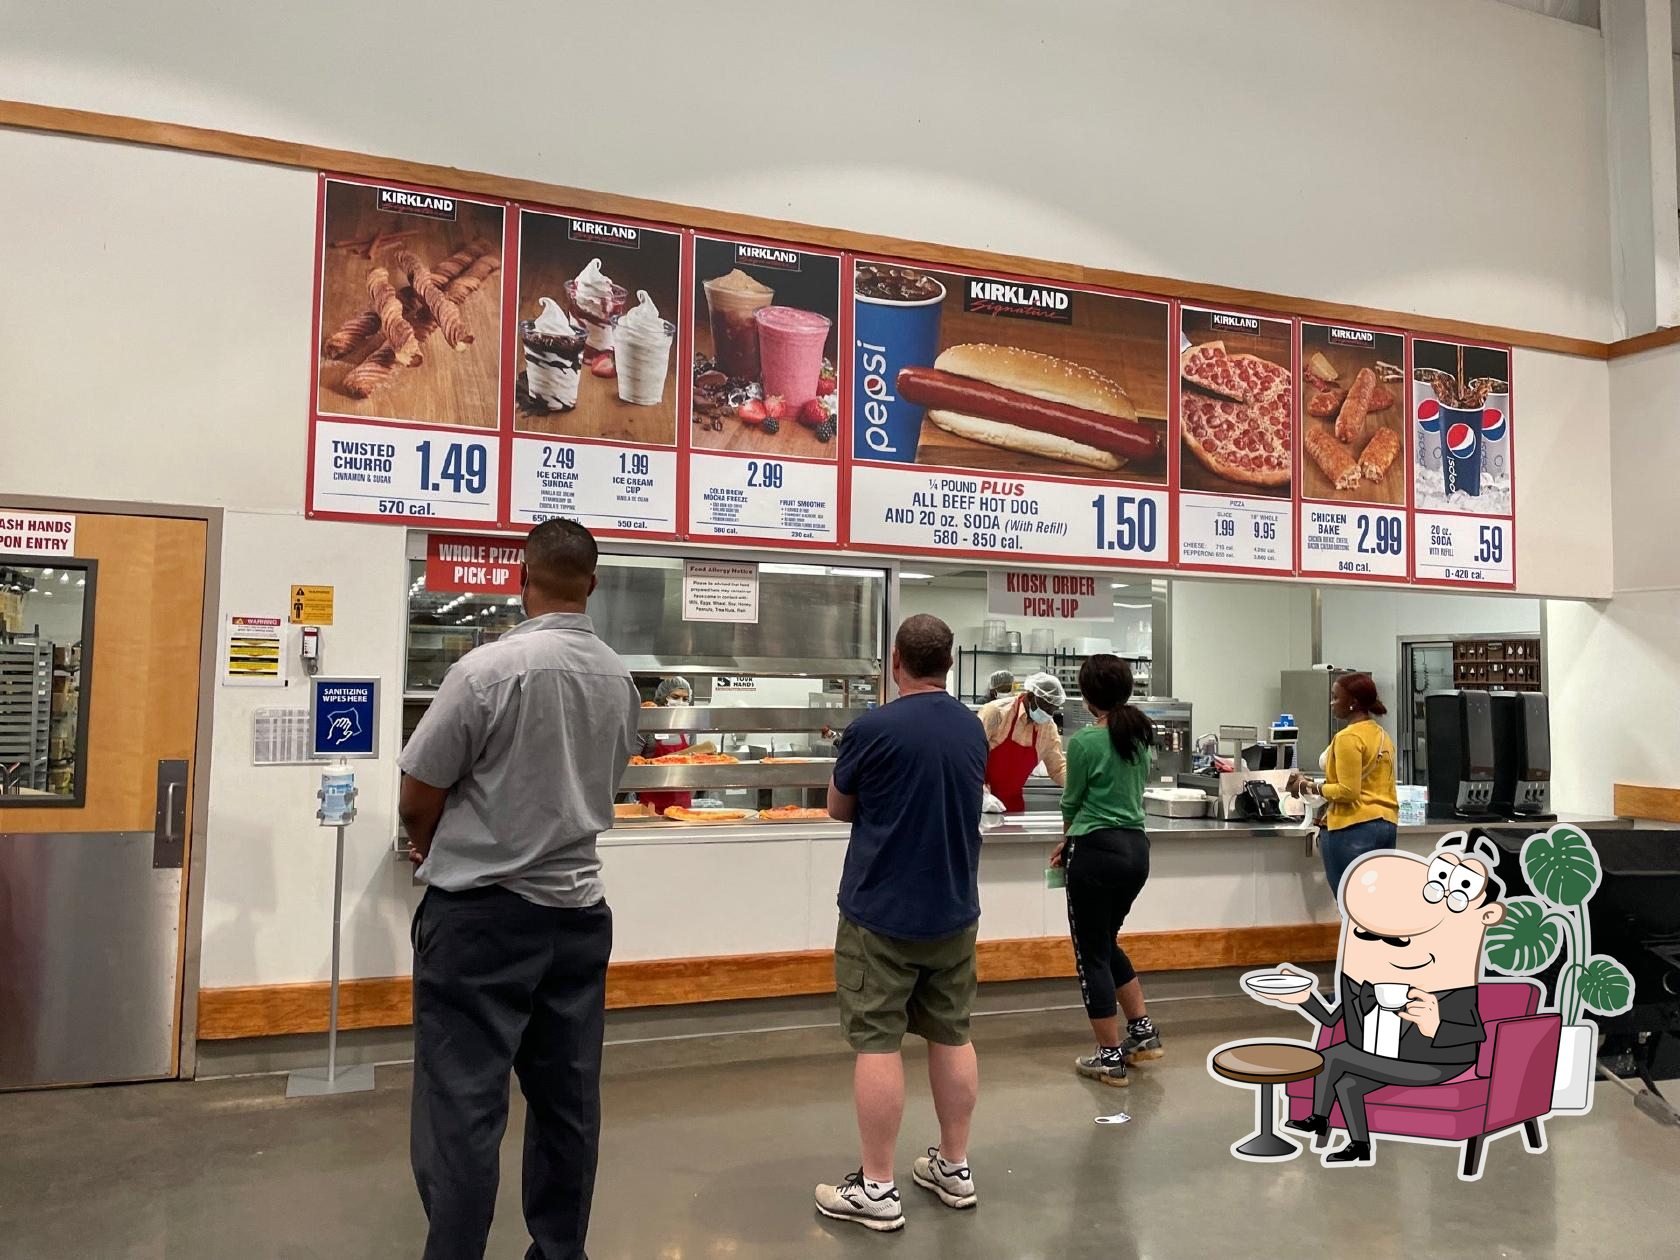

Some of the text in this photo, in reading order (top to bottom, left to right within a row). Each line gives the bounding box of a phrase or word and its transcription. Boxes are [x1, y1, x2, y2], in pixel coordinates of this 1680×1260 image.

[382, 191, 453, 212] KIRKLAND
[572, 220, 636, 240] KIRKLAND
[738, 246, 796, 262] KIRKLAND
[971, 282, 1068, 310] KIRKLAND
[970, 300, 1068, 319] Signature
[1214, 314, 1258, 328] KIRKLAND
[1332, 328, 1372, 341] KIRKLAND
[857, 340, 896, 452] pepsi
[332, 440, 395, 458] TWISTED
[542, 446, 575, 470] 2.49
[334, 456, 392, 472] CHURRO
[416, 440, 487, 494] 1.49
[620, 452, 648, 475] 1.99
[334, 472, 391, 484] CINNAMON & SUGAR
[537, 470, 578, 480] ICE CREAM
[627, 478, 653, 486] CREAM
[747, 461, 782, 488] 2.99
[1446, 456, 1457, 492] pepsi
[542, 480, 573, 488] SUNDAE
[941, 480, 977, 493] POUND
[980, 480, 1025, 496] PLUS
[379, 500, 435, 515] 570 cal.
[912, 492, 1038, 515] ALL BEEF HOT DOG
[28, 520, 72, 533] HANDS
[885, 508, 1067, 536] AND 20 oz. SODA (With Refill)
[1092, 494, 1156, 552] 1.50
[1312, 512, 1347, 524] CHICKEN
[1214, 519, 1234, 536] 1.99
[1254, 522, 1275, 540] 9.95
[1318, 524, 1340, 535] BAKE
[1357, 514, 1402, 555] 2.99
[1431, 525, 1440, 534] 20
[26, 537, 68, 550] ENTRY
[934, 530, 958, 545] 580
[973, 533, 996, 548] 850
[1001, 535, 1023, 550] cal.
[1431, 536, 1452, 546] SODA
[1474, 525, 1502, 563] .59
[439, 544, 525, 565] WHOLE PIZZA
[454, 566, 509, 585] PICK-UP
[1339, 561, 1371, 572] 840 cal.
[1471, 571, 1484, 580] cal.
[1007, 572, 1095, 596] KIOSK ORDER
[1024, 597, 1079, 618] PICK-UP
